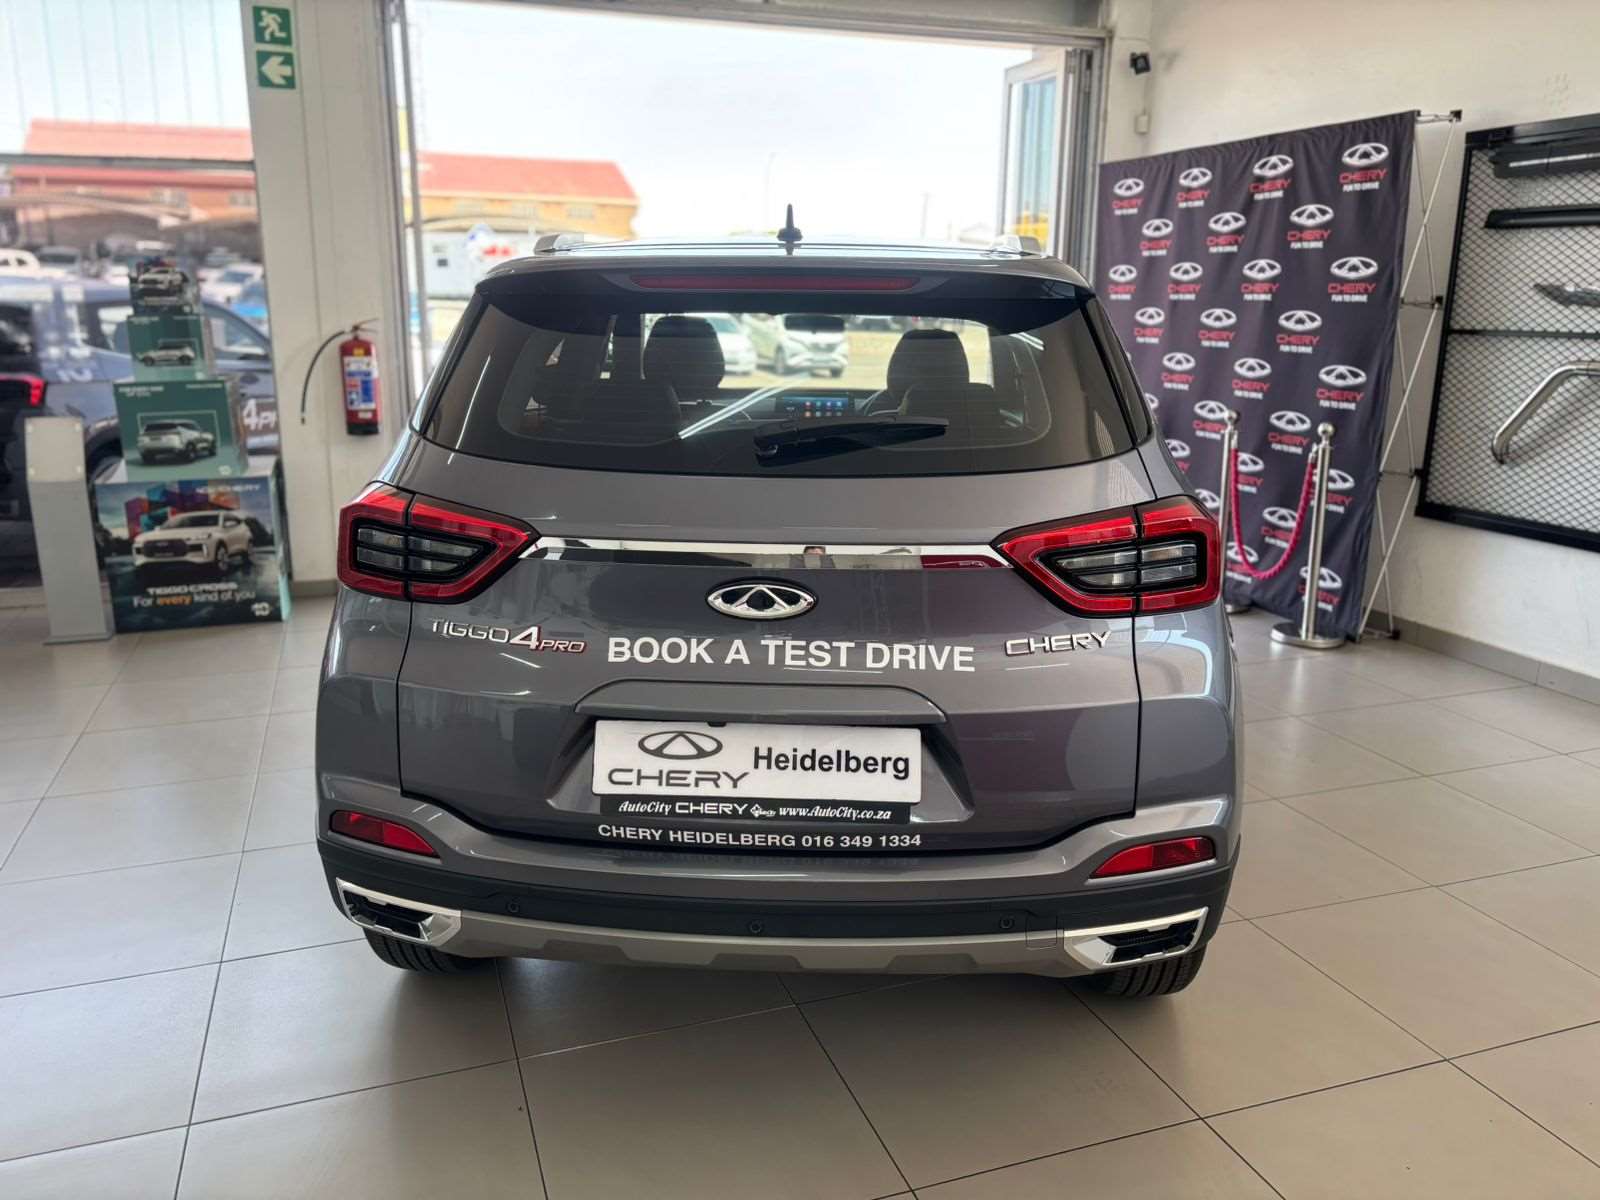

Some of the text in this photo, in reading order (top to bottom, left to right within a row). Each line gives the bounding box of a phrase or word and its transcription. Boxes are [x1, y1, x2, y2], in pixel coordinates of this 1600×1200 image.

[1339, 168, 1387, 184] CHERY
[1249, 178, 1291, 193] CHERY
[1177, 189, 1211, 202] CHERY
[1206, 234, 1245, 247] CHERY
[1287, 229, 1332, 242] CHERY
[1168, 284, 1202, 294] CHERY
[1241, 282, 1280, 293] CHERY
[1327, 283, 1376, 294] CHERY
[1198, 330, 1236, 341] CHERY
[1276, 334, 1320, 345] CHERY
[1232, 379, 1270, 392] CHERY
[1316, 388, 1364, 402] CHERY
[1268, 432, 1310, 446] CHERY
[133, 597, 152, 607] For
[157, 595, 191, 606] every
[193, 591, 217, 601] kind
[234, 591, 255, 602] you
[1004, 630, 1112, 657] CHERY
[607, 637, 975, 673] BOOK A TEST DRIVE
[753, 746, 910, 781] Heidelberg
[608, 768, 750, 789] CHERY
[618, 801, 672, 816] AutoCity
[675, 802, 748, 815] CHERY
[779, 805, 892, 821] www.AutoCity.co.za
[598, 824, 922, 847] CHERY HEIDELBERG 016 349 1334
